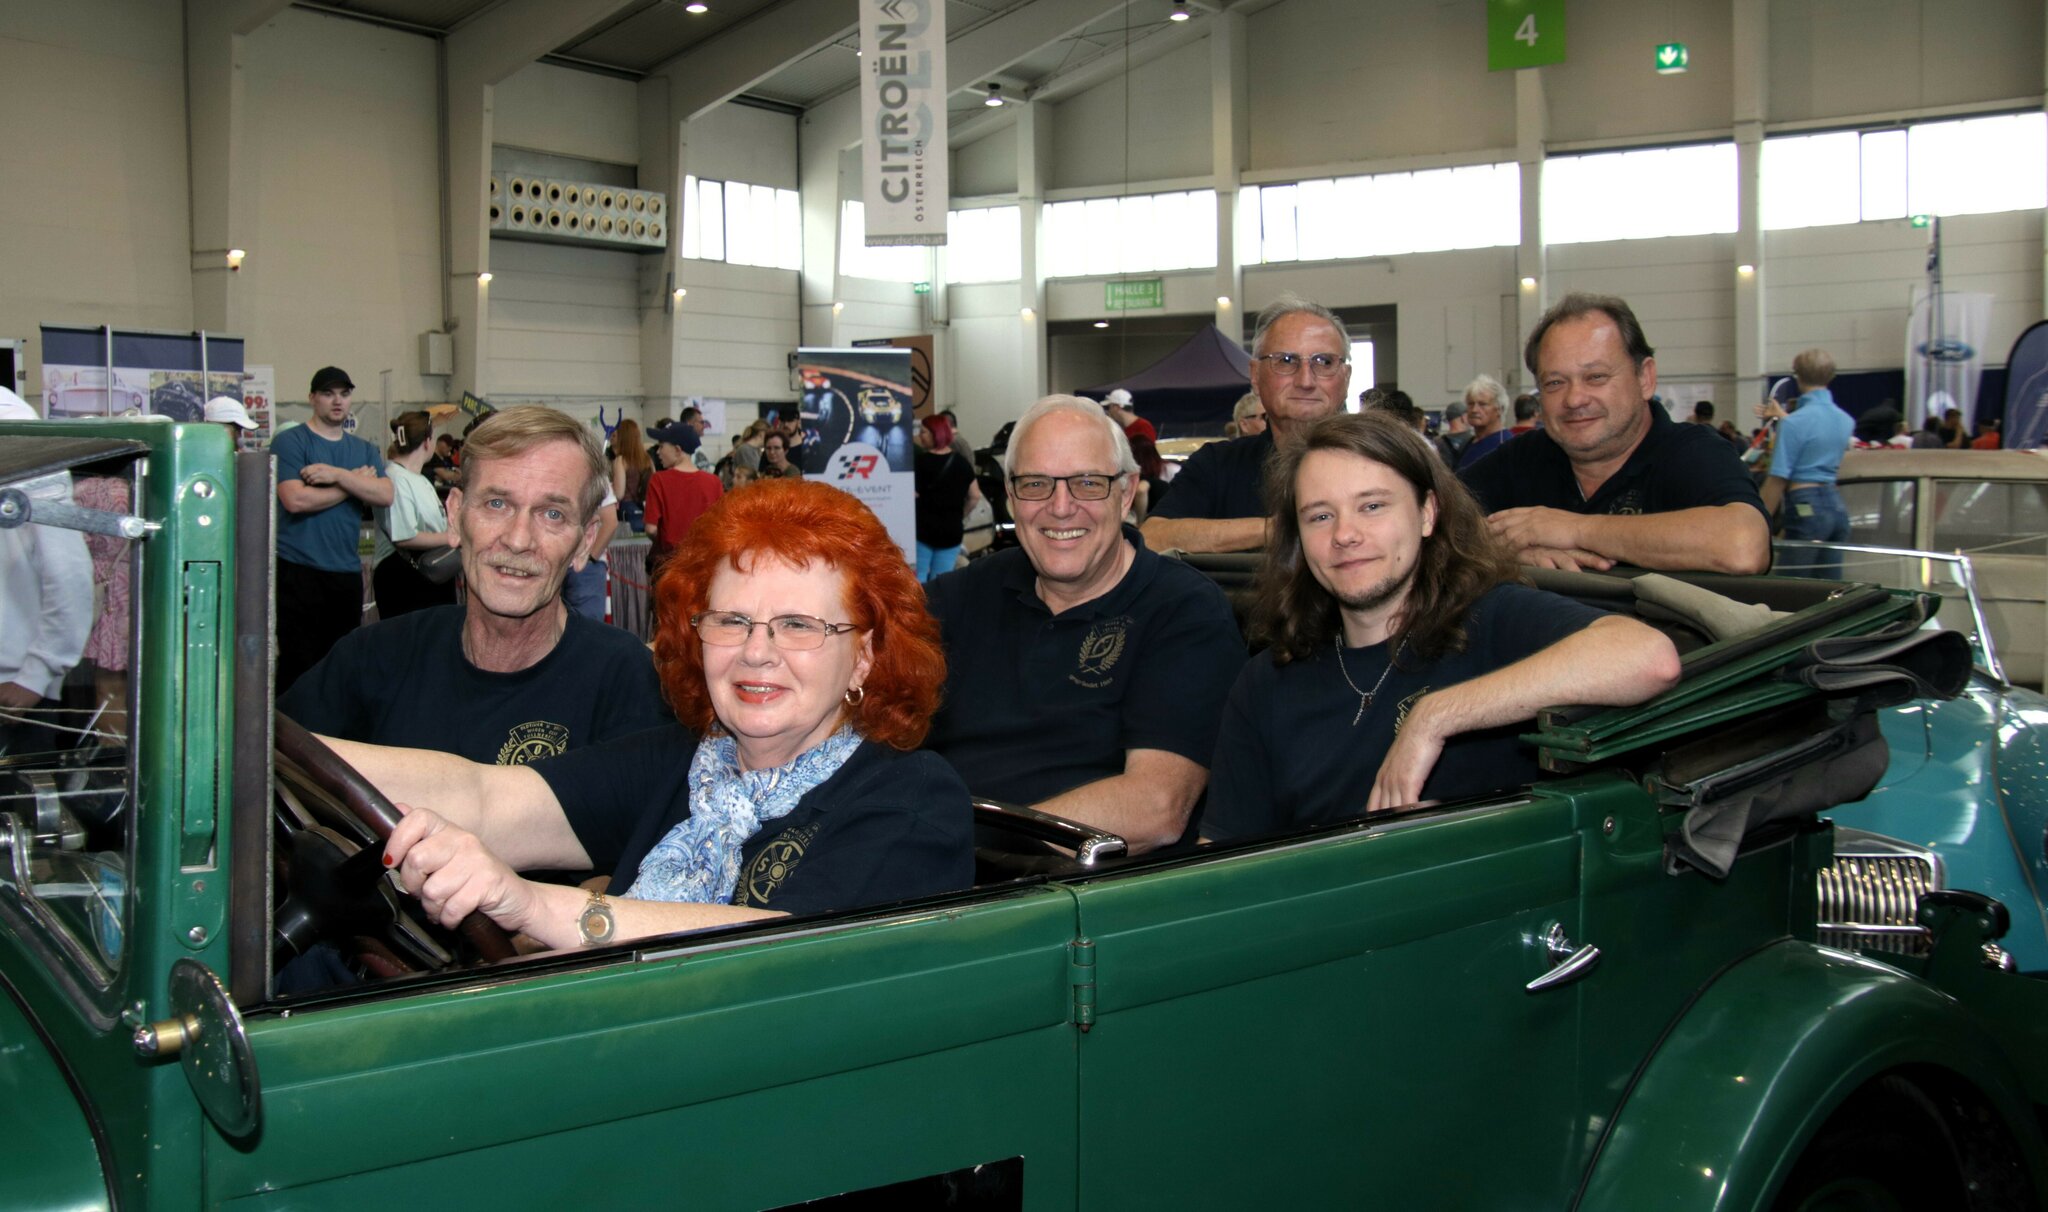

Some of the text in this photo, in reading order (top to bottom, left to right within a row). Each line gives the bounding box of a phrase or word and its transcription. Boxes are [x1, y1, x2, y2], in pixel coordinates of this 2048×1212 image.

[1514, 14, 1539, 47] 4
[872, 24, 910, 204] CITROËN
[915, 140, 924, 222] ÖSTERREICH
[1115, 284, 1154, 296] HALLE 3
